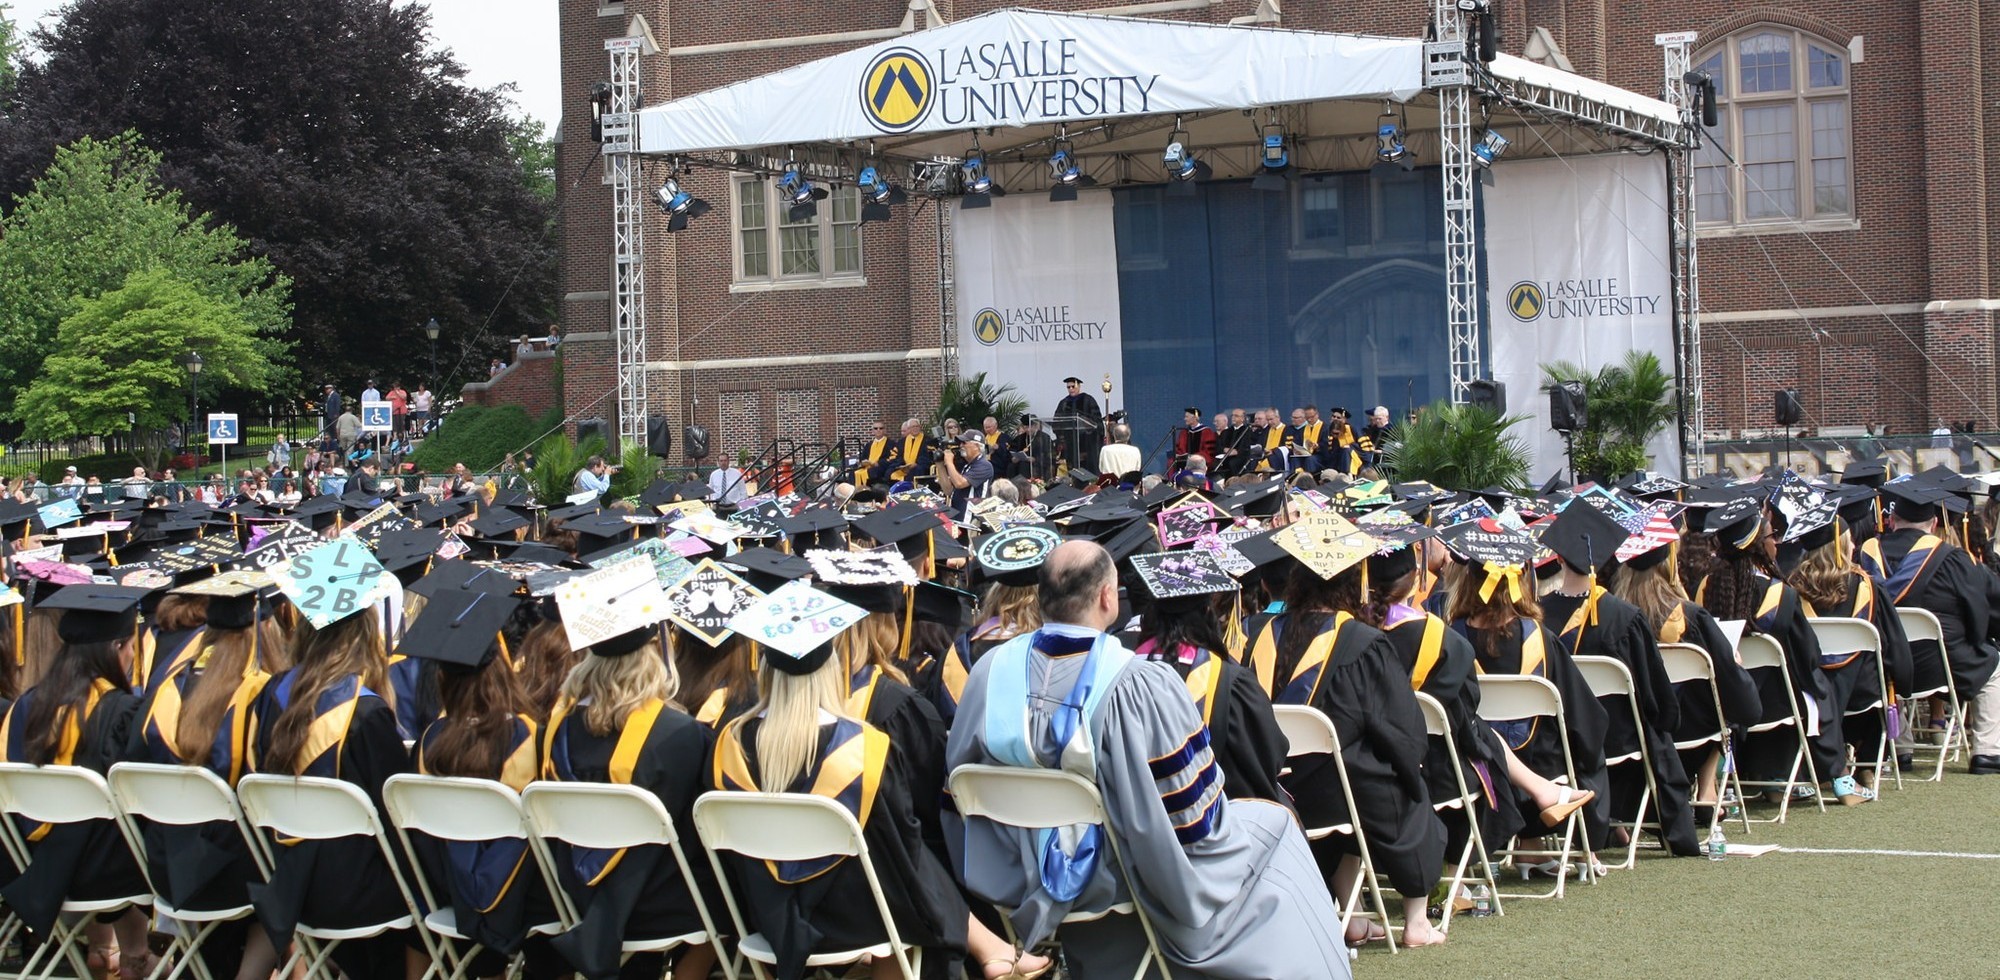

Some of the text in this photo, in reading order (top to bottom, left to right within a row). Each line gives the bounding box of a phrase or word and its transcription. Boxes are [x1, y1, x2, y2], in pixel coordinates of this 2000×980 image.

[940, 74, 1161, 125] UNIVERSITY
[1548, 295, 1661, 319] UNIVERSITY
[1006, 321, 1107, 343] UNIVERSITY
[1317, 517, 1339, 525] DID
[1324, 529, 1339, 537] IT
[1467, 544, 1499, 554] Thank
[1479, 553, 1505, 561] mom
[811, 615, 847, 634] be
